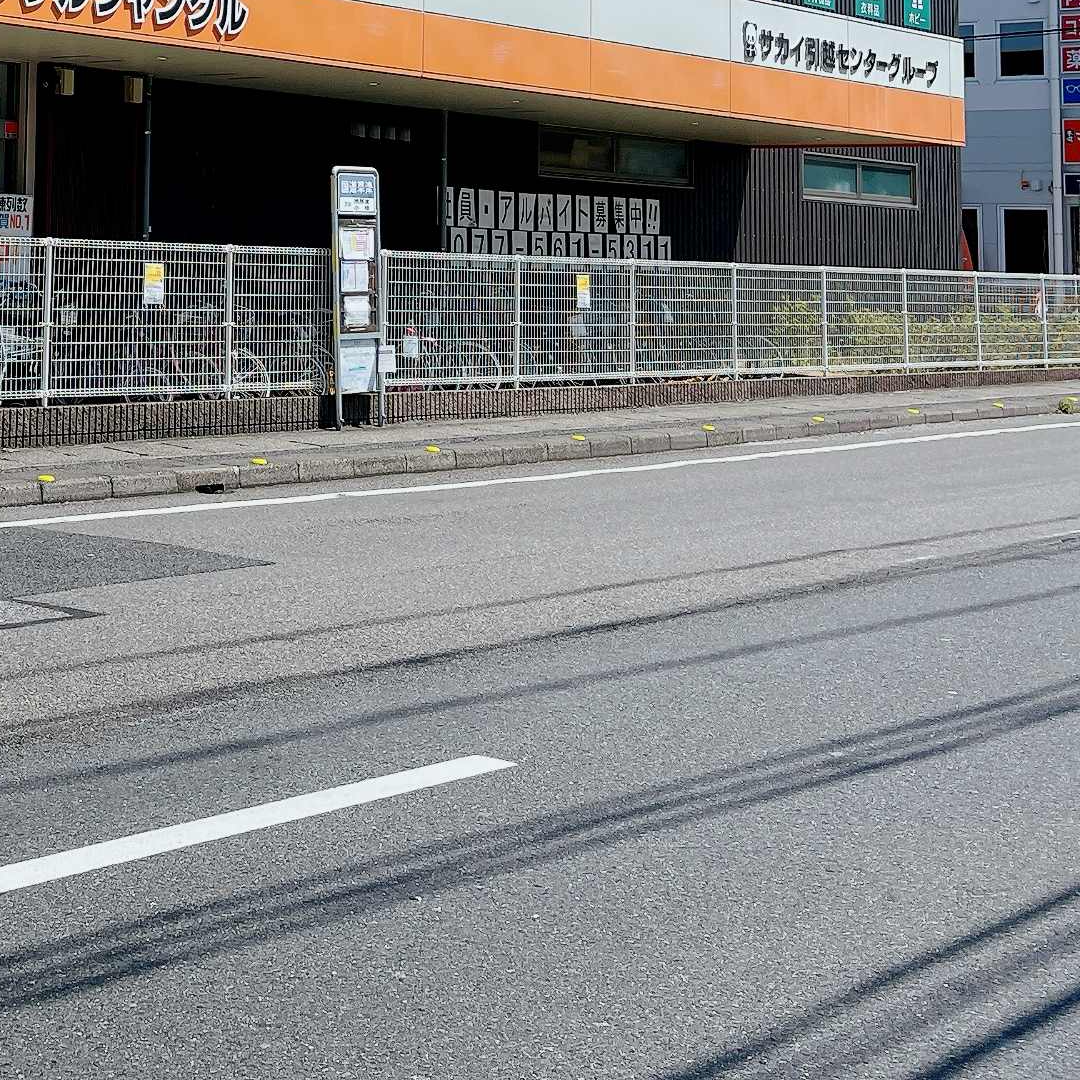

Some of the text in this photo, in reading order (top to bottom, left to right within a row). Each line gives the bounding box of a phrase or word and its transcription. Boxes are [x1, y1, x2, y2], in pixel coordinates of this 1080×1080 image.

[860, 2, 880, 17] 衣料品
[908, 12, 926, 25] ホビー
[758, 29, 939, 88] サカイ引越センターグループ
[453, 233, 669, 260] 077-561-5311
